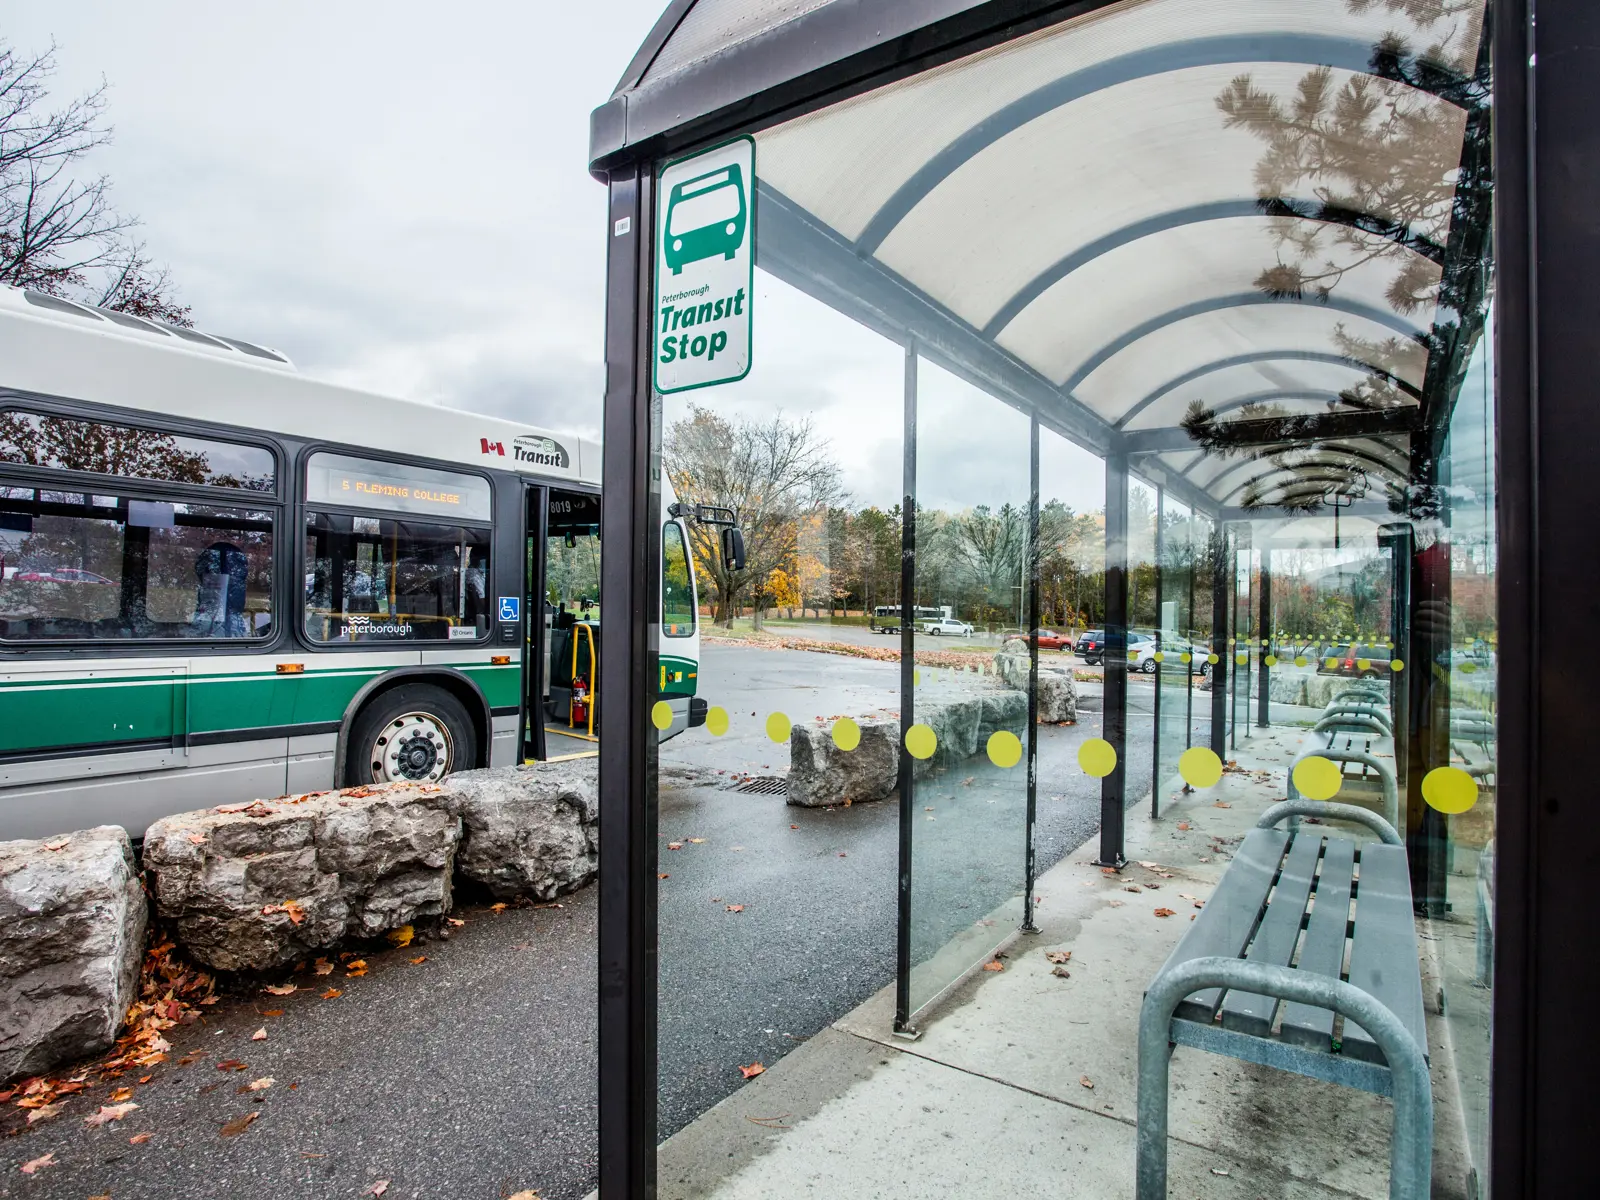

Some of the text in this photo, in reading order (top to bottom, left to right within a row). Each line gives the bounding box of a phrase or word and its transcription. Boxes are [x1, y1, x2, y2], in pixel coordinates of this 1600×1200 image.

[662, 284, 709, 304] Peterborough
[661, 287, 745, 333] Transit
[660, 330, 727, 363] Stop
[513, 438, 541, 448] Peterborough
[513, 445, 561, 467] Transit
[356, 482, 408, 497] FLEMING
[413, 489, 459, 504] COLLEGE
[550, 500, 571, 514] 8019
[340, 622, 412, 637] peterborough
